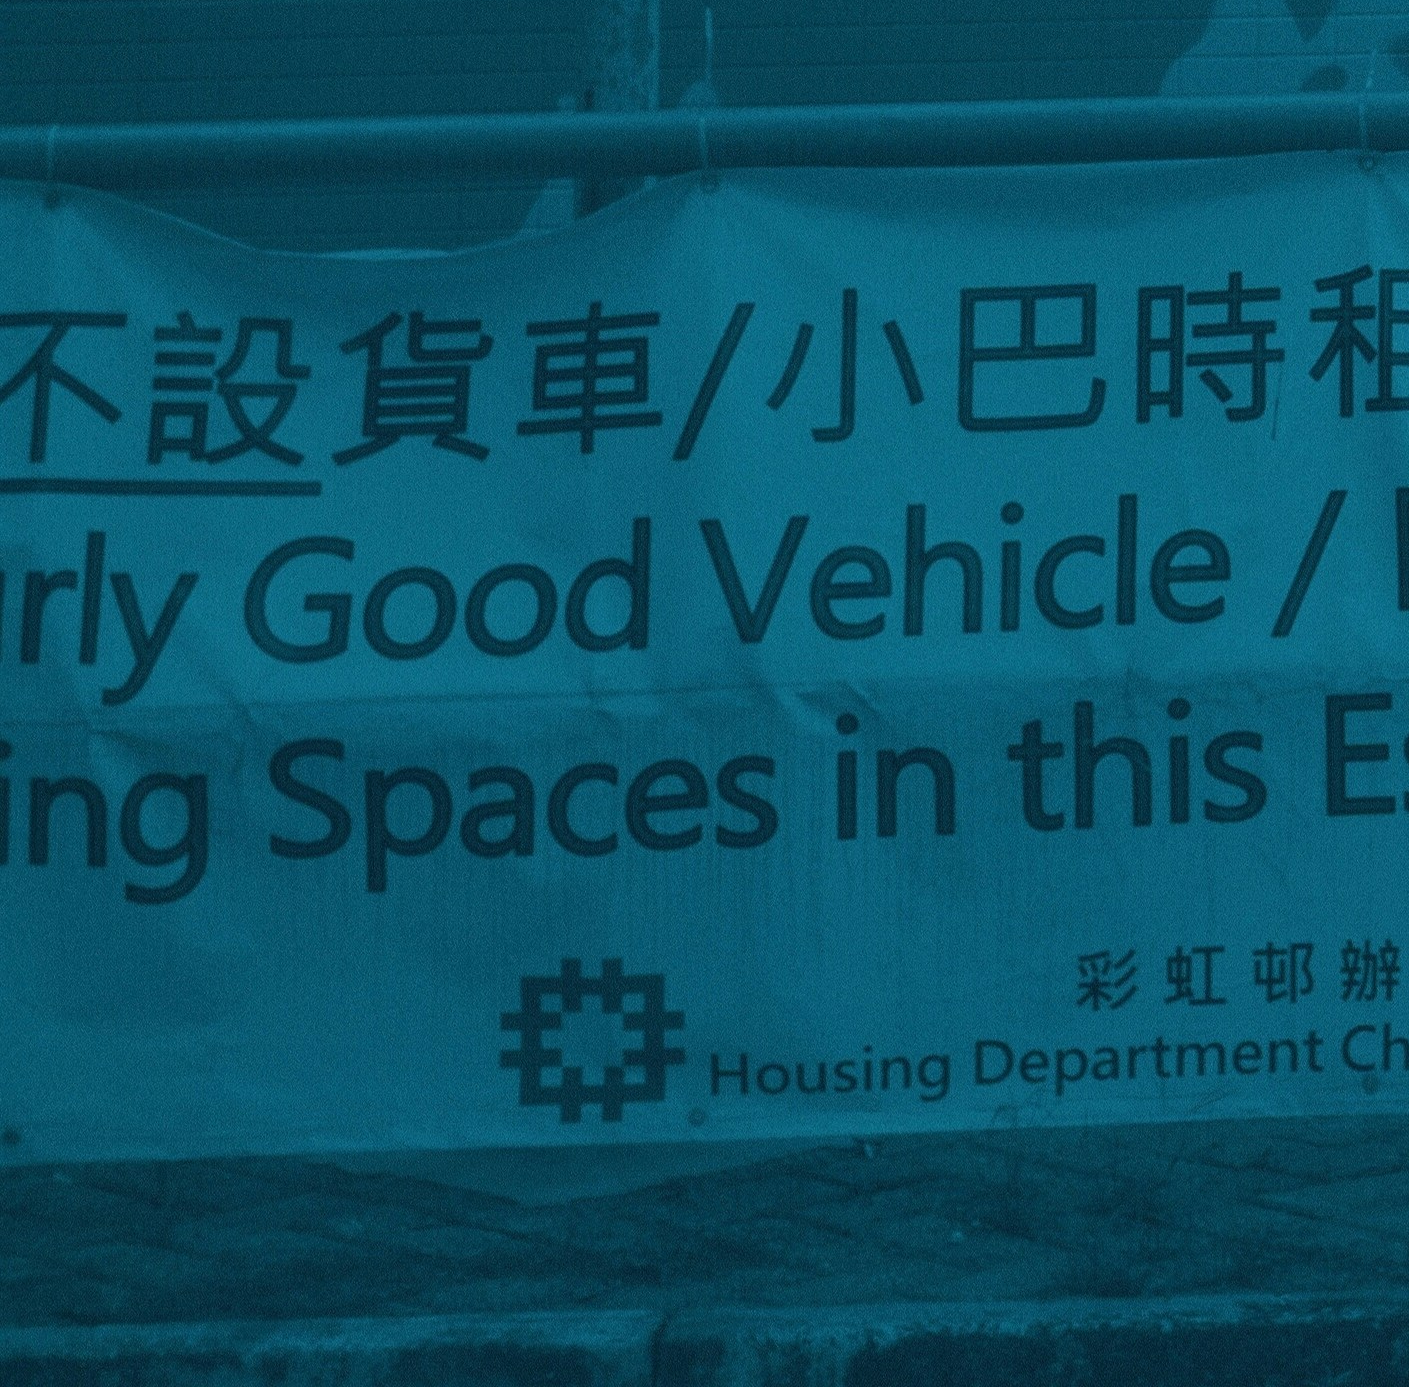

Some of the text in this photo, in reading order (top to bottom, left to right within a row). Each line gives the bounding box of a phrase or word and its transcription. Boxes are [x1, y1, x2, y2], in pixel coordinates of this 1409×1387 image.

[0, 532, 197, 707] rly
[244, 516, 651, 663] Good
[699, 494, 1231, 645] Vehicle
[1271, 488, 1348, 638] /
[268, 738, 777, 893] Spaces
[837, 713, 955, 839] in
[1007, 698, 1267, 831] this
[709, 1044, 950, 1101] Housing
[975, 1031, 1323, 1095] Department
